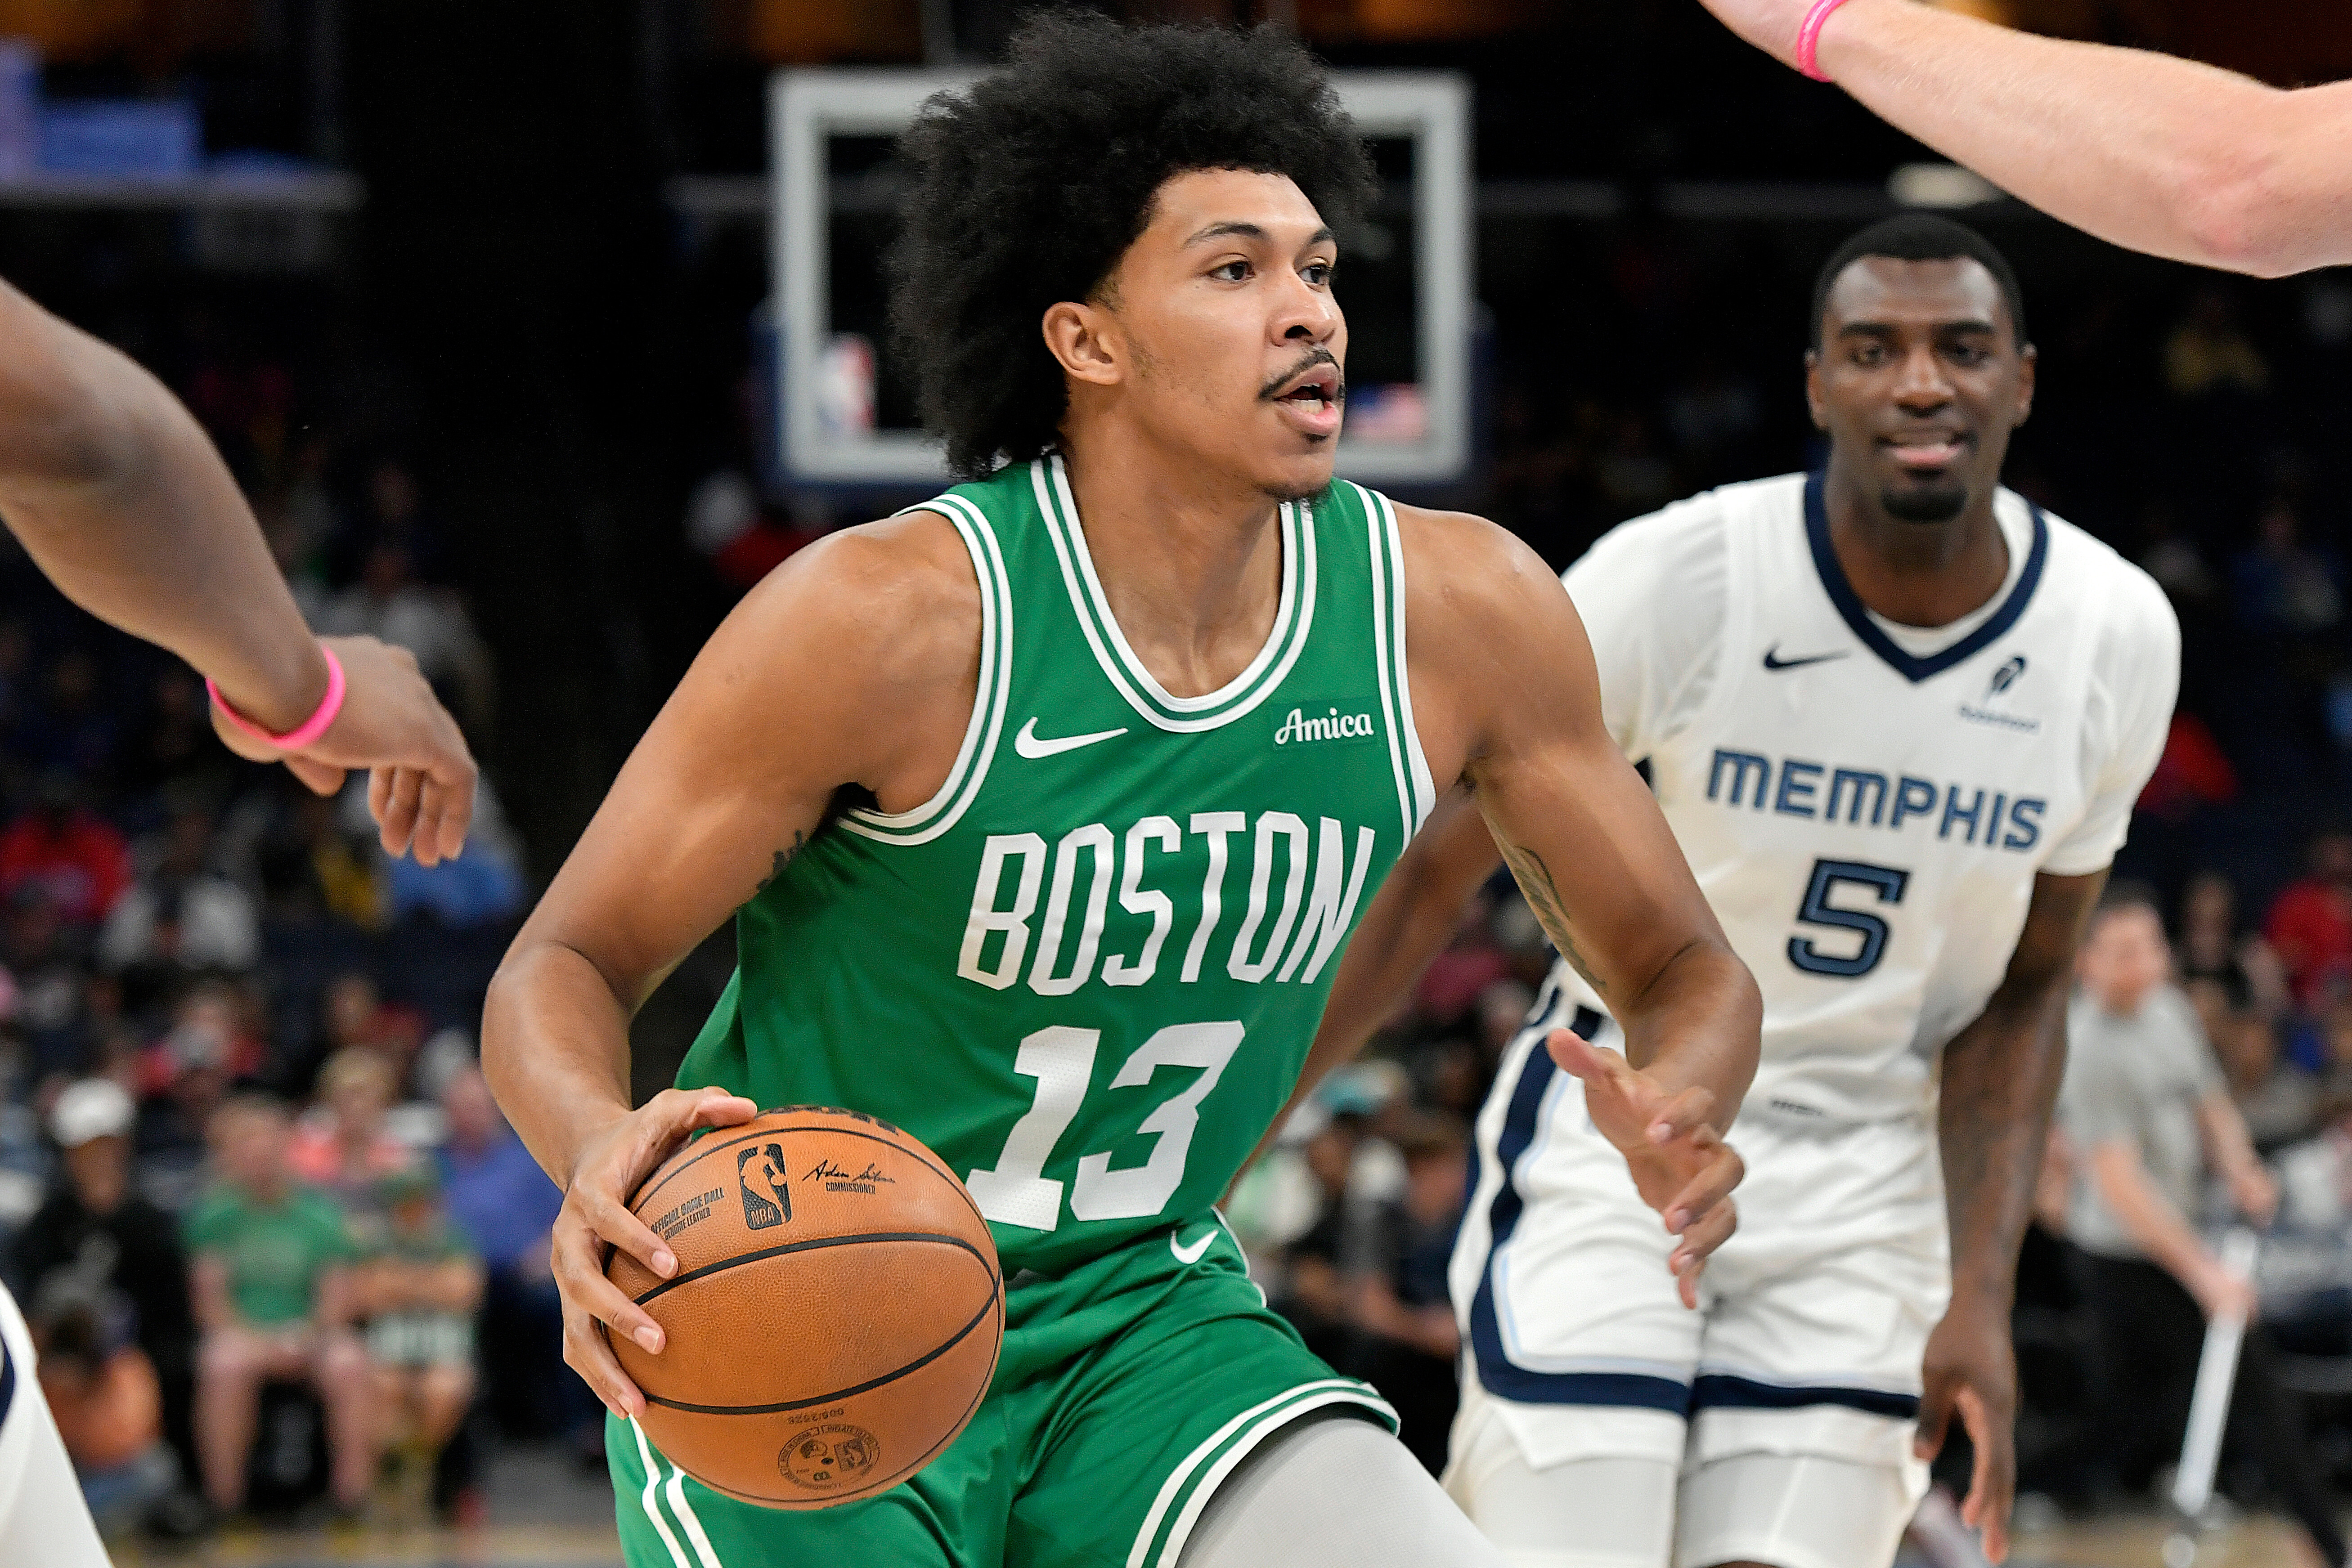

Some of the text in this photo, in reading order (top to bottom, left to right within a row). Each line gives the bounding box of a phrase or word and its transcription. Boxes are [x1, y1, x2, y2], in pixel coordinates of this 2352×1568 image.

[1274, 707, 1374, 745] Amica
[1707, 748, 2047, 851] MEMPHIS
[957, 811, 1376, 996] BOSTON
[1786, 858, 1910, 977] 5
[965, 1020, 1246, 1232] 13
[651, 1187, 725, 1234] OFFICIAL GAME BALL
[826, 1182, 876, 1195] COMMISSIONER
[686, 1207, 711, 1227] LEATHER
[750, 1206, 775, 1227] NBA
